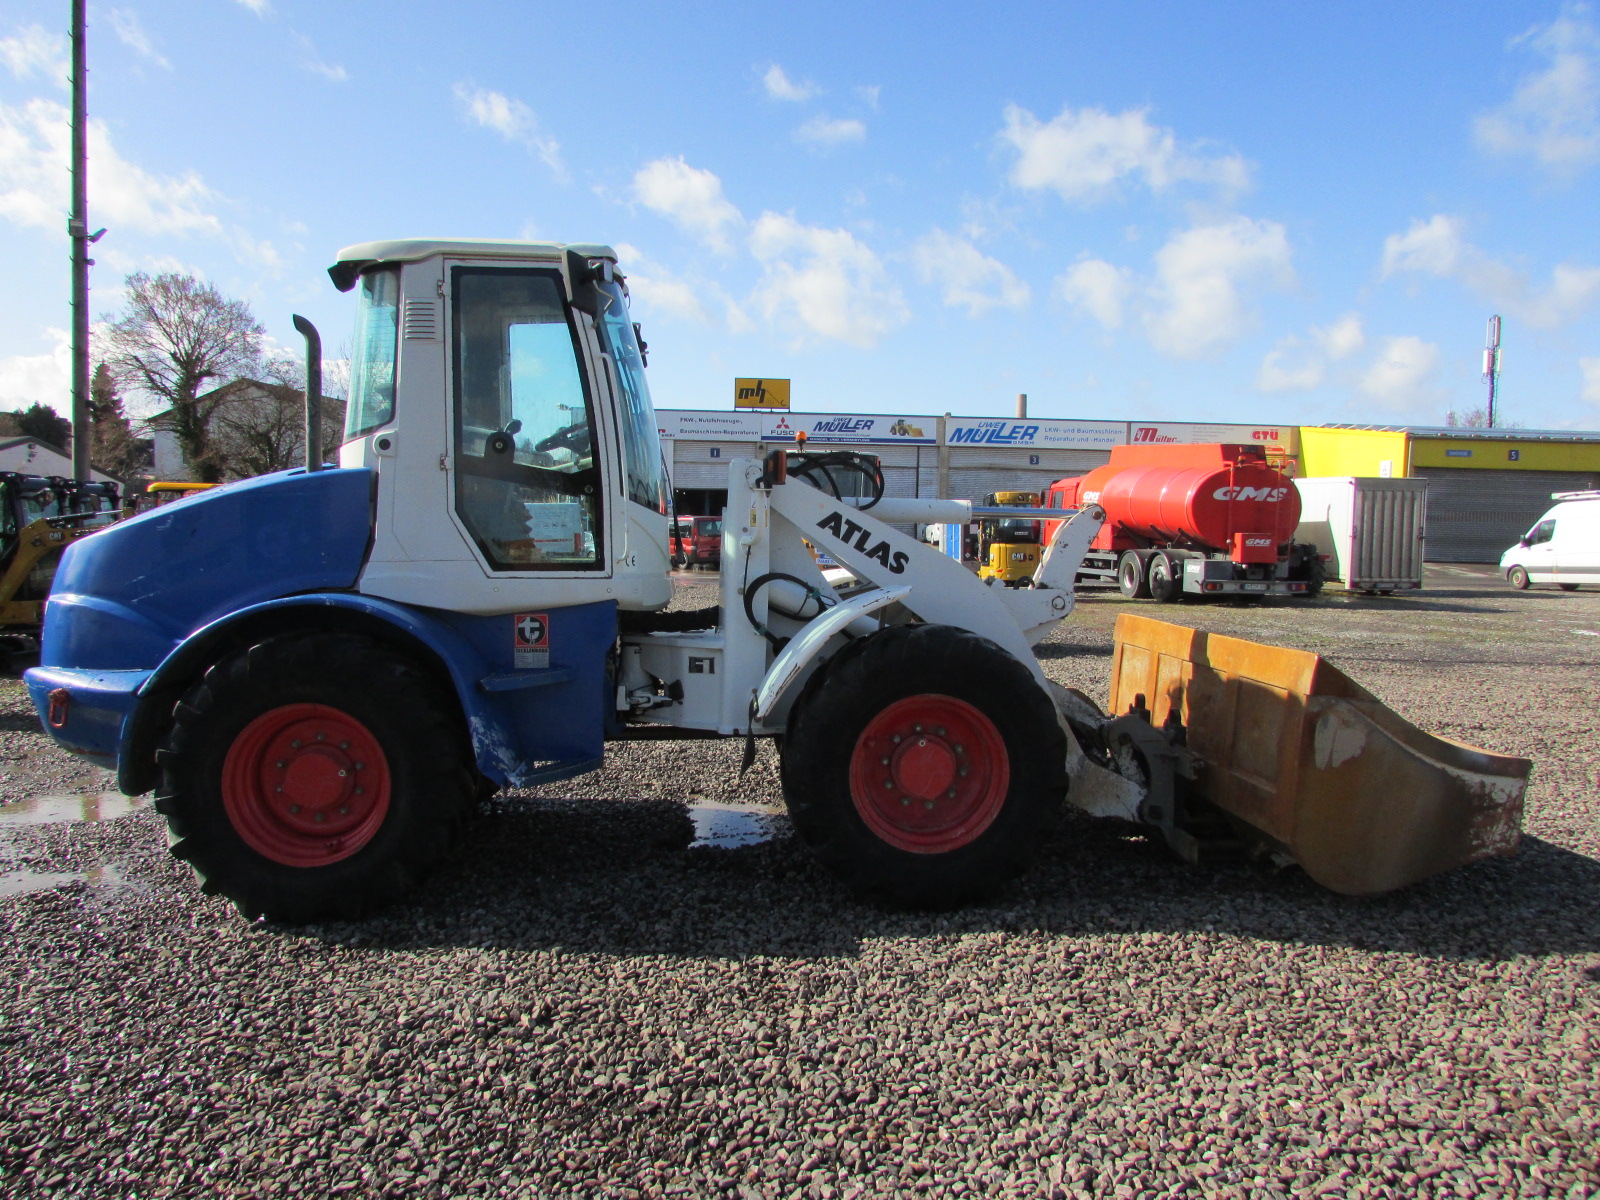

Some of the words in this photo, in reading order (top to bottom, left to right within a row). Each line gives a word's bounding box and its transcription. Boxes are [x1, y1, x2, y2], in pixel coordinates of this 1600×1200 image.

[812, 417, 875, 433] MÜLLER
[948, 422, 1040, 445] MÜLLER
[1251, 428, 1279, 441] GTÜ
[1510, 451, 1516, 460] 5
[1083, 491, 1100, 500] GMS
[1212, 486, 1288, 502] GMS
[816, 511, 910, 575] ATLAS
[1245, 538, 1272, 546] GMS
[1011, 552, 1024, 561] CAT
